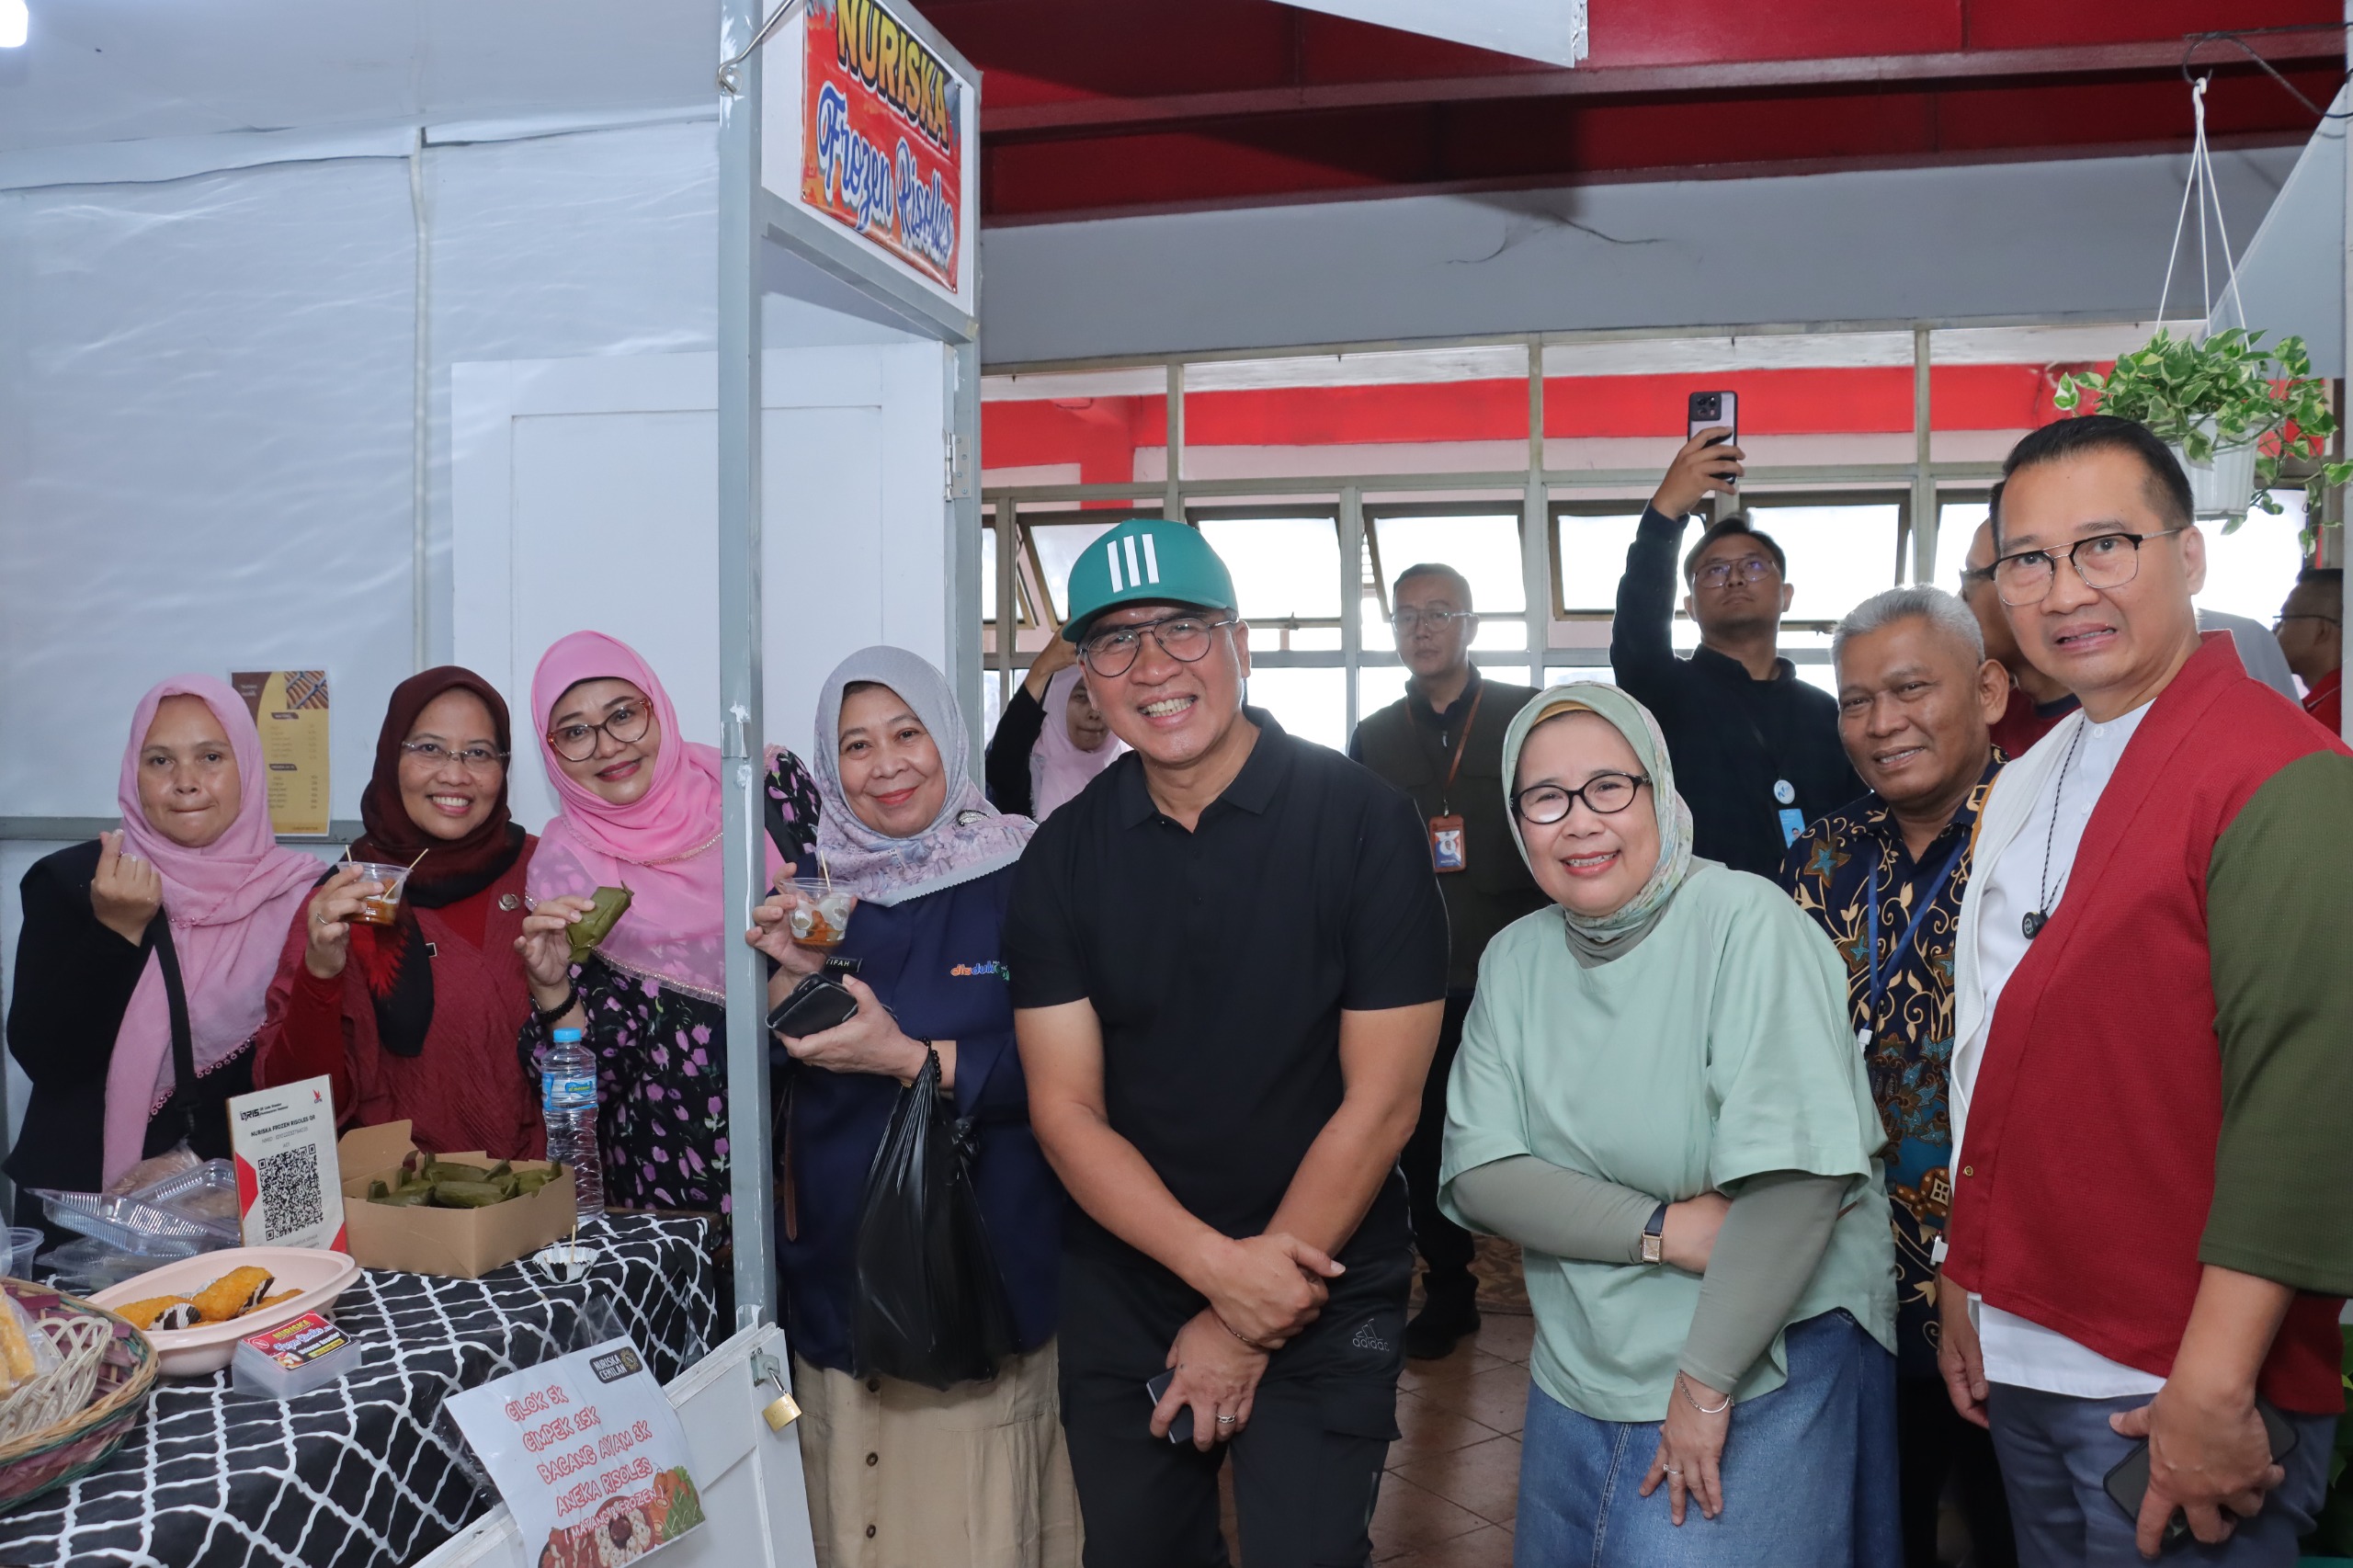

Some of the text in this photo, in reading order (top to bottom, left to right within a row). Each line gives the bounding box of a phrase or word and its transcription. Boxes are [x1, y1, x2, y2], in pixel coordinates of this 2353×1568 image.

[836, 0, 949, 153] NURISKA
[817, 82, 893, 232] Frozen
[240, 1108, 260, 1121] QRIS
[251, 1127, 272, 1137] NURISKA
[272, 1122, 290, 1131] FROZEN
[290, 1116, 309, 1126] RISOLES
[272, 1320, 313, 1339] NURISKA
[1352, 1337, 1390, 1352] adidas
[593, 1354, 622, 1370] NURISKA
[599, 1364, 627, 1380] CEMILAN
[506, 1385, 569, 1422] CILOK 5K
[522, 1406, 601, 1452] CIMPEK 15K
[537, 1420, 653, 1484] BACANG AYAM 3K
[556, 1457, 653, 1517] ANEKA RISOLES
